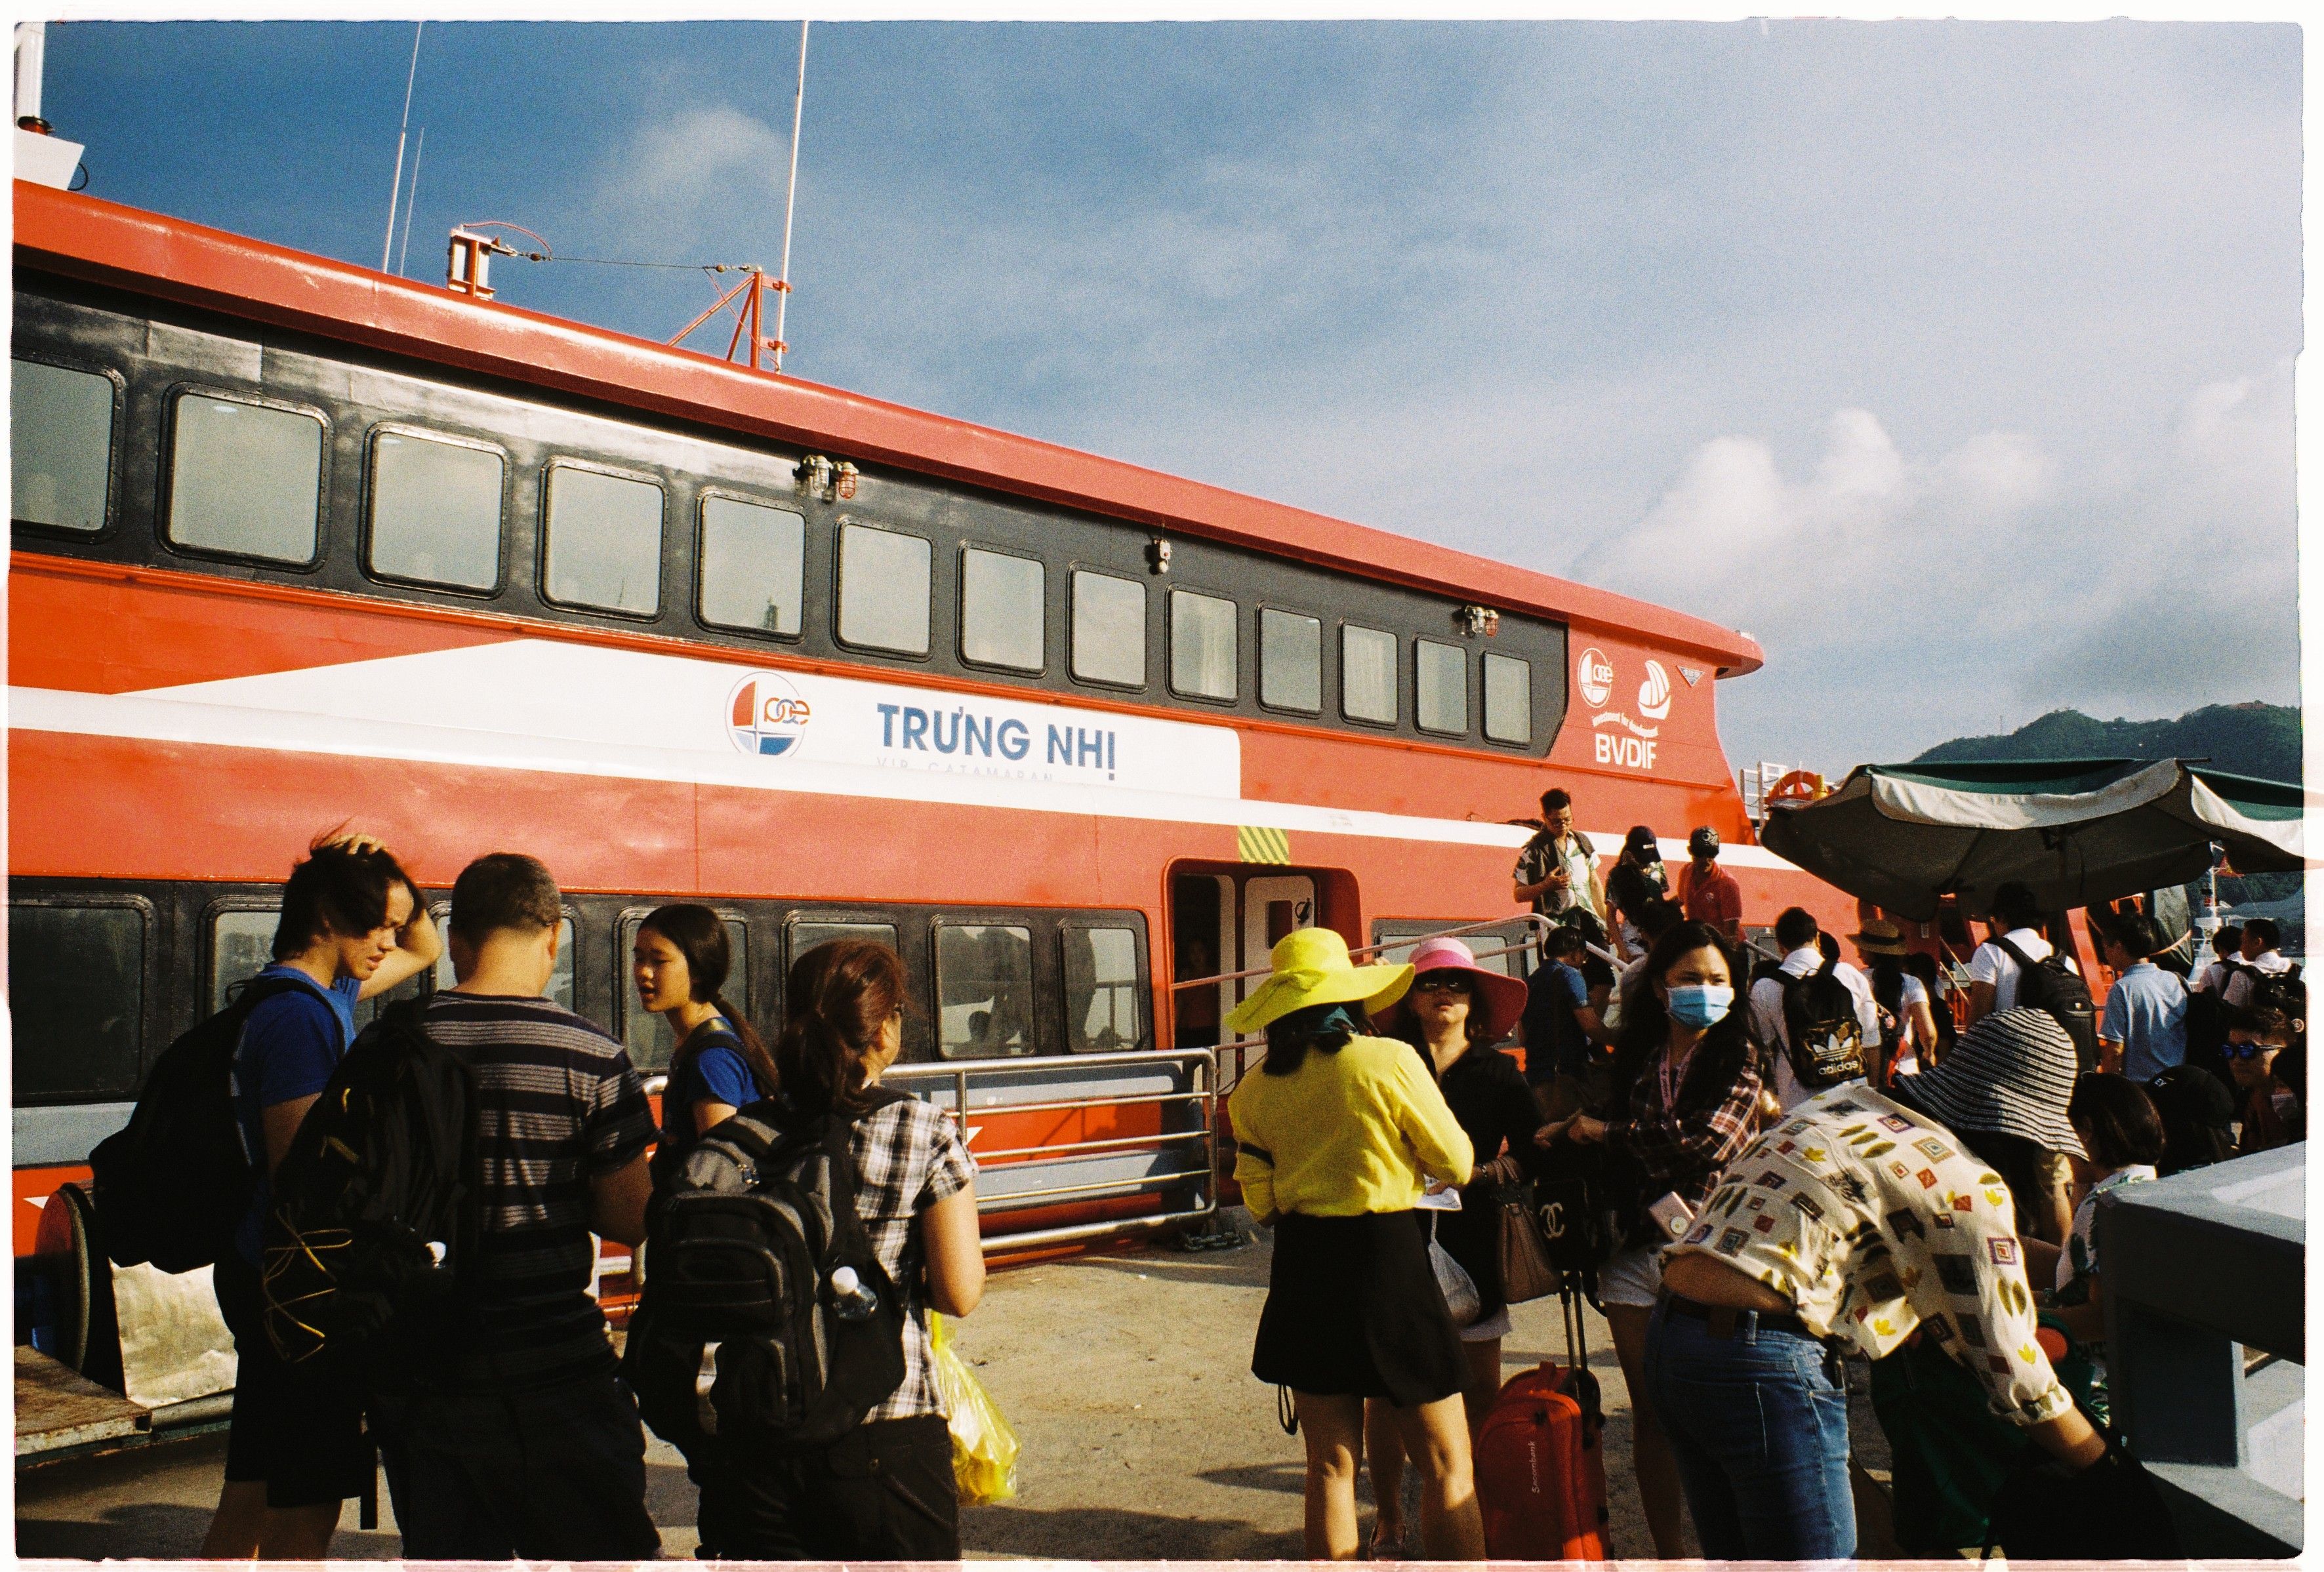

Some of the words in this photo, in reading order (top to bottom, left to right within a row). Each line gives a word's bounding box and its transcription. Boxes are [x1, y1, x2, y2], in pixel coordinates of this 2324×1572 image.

[877, 703, 1030, 761] TRƯNG
[1048, 723, 1115, 780] NHỊ
[1595, 733, 1658, 770] BVDIF
[1818, 1060, 1858, 1075] adidas
